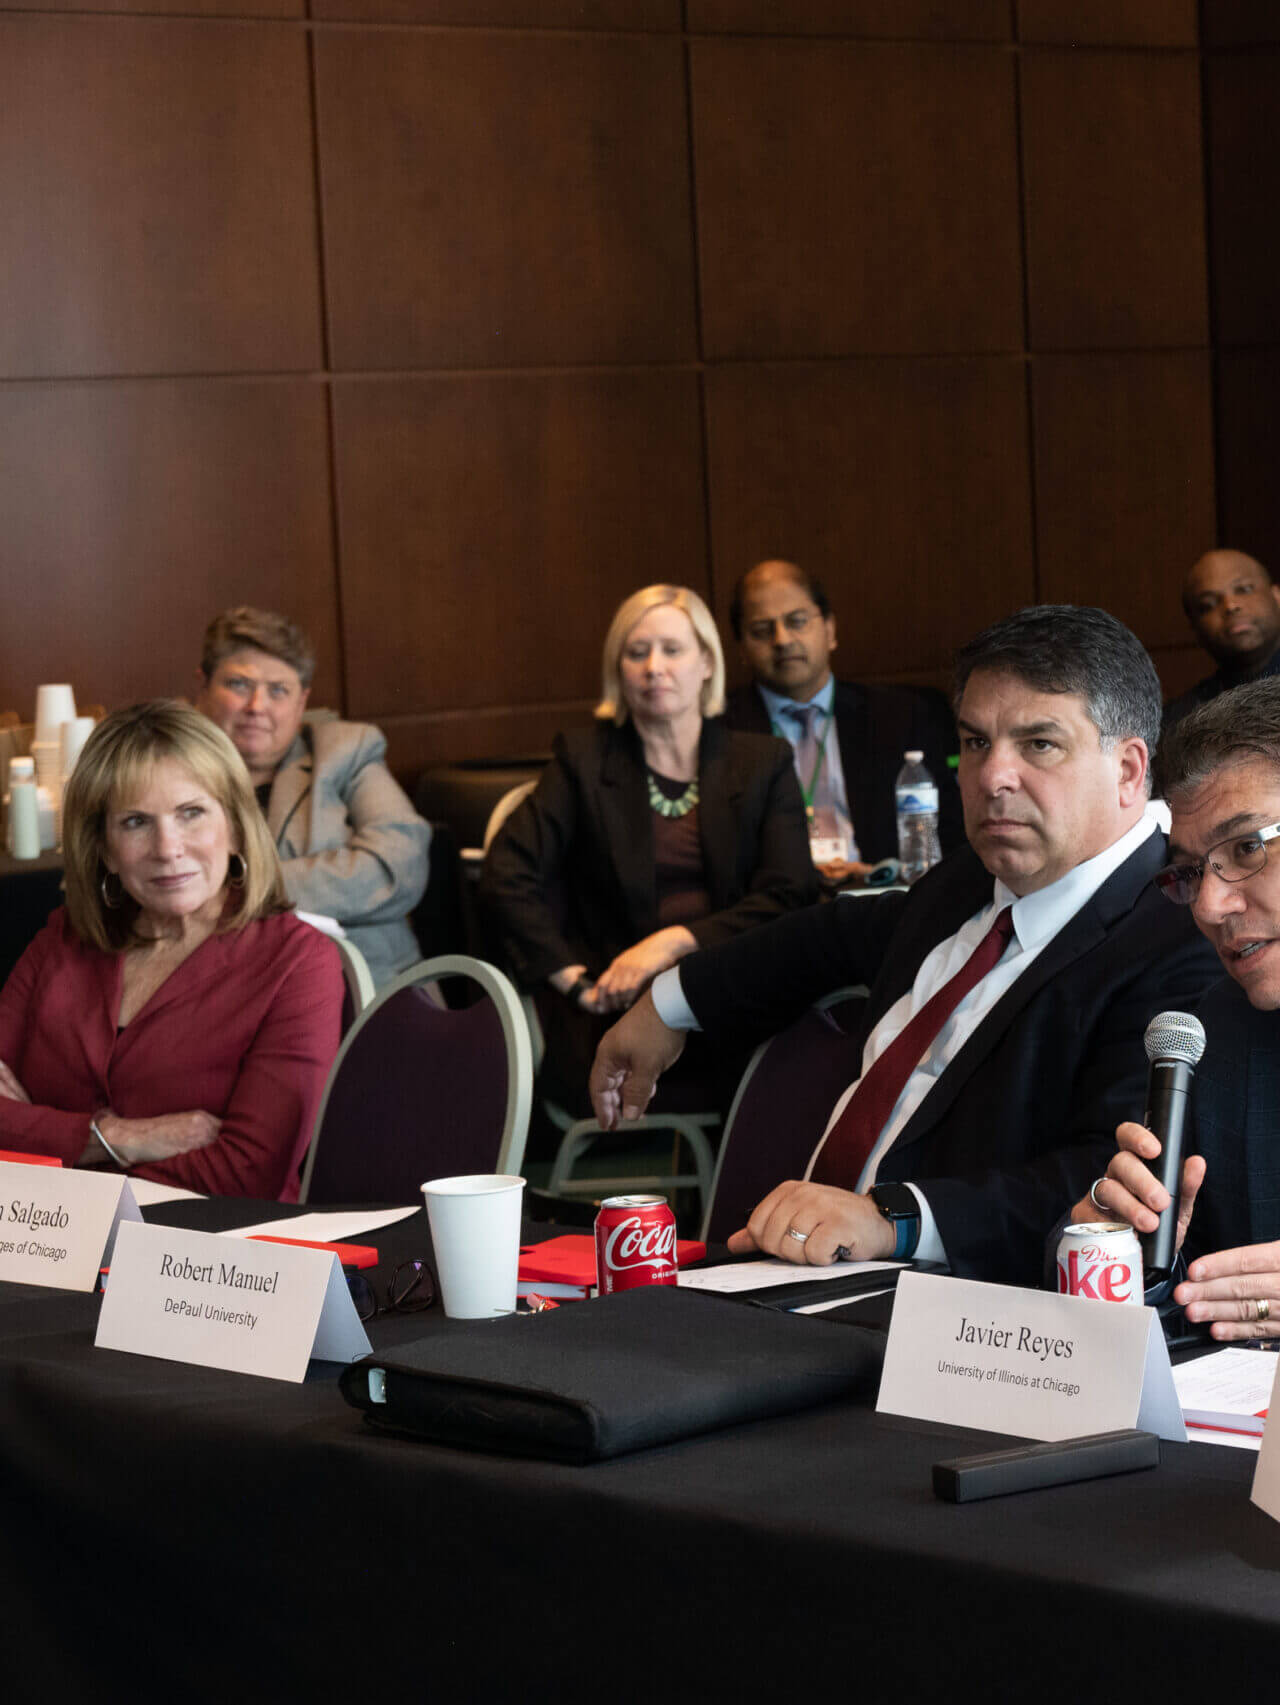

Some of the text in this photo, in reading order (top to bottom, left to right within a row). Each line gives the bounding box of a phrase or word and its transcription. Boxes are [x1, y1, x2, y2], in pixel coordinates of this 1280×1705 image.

[8, 1200, 69, 1231] Salgado
[16, 1241, 28, 1254] of
[28, 1242, 67, 1261] Chicago
[605, 1216, 678, 1271] Coca
[160, 1254, 279, 1294] Robert Manuel
[1057, 1250, 1132, 1303] ke
[164, 1298, 258, 1330] DePaul University
[955, 1317, 1074, 1361] Javier Reyes
[937, 1359, 1080, 1396] University of Illinois at Chicago
